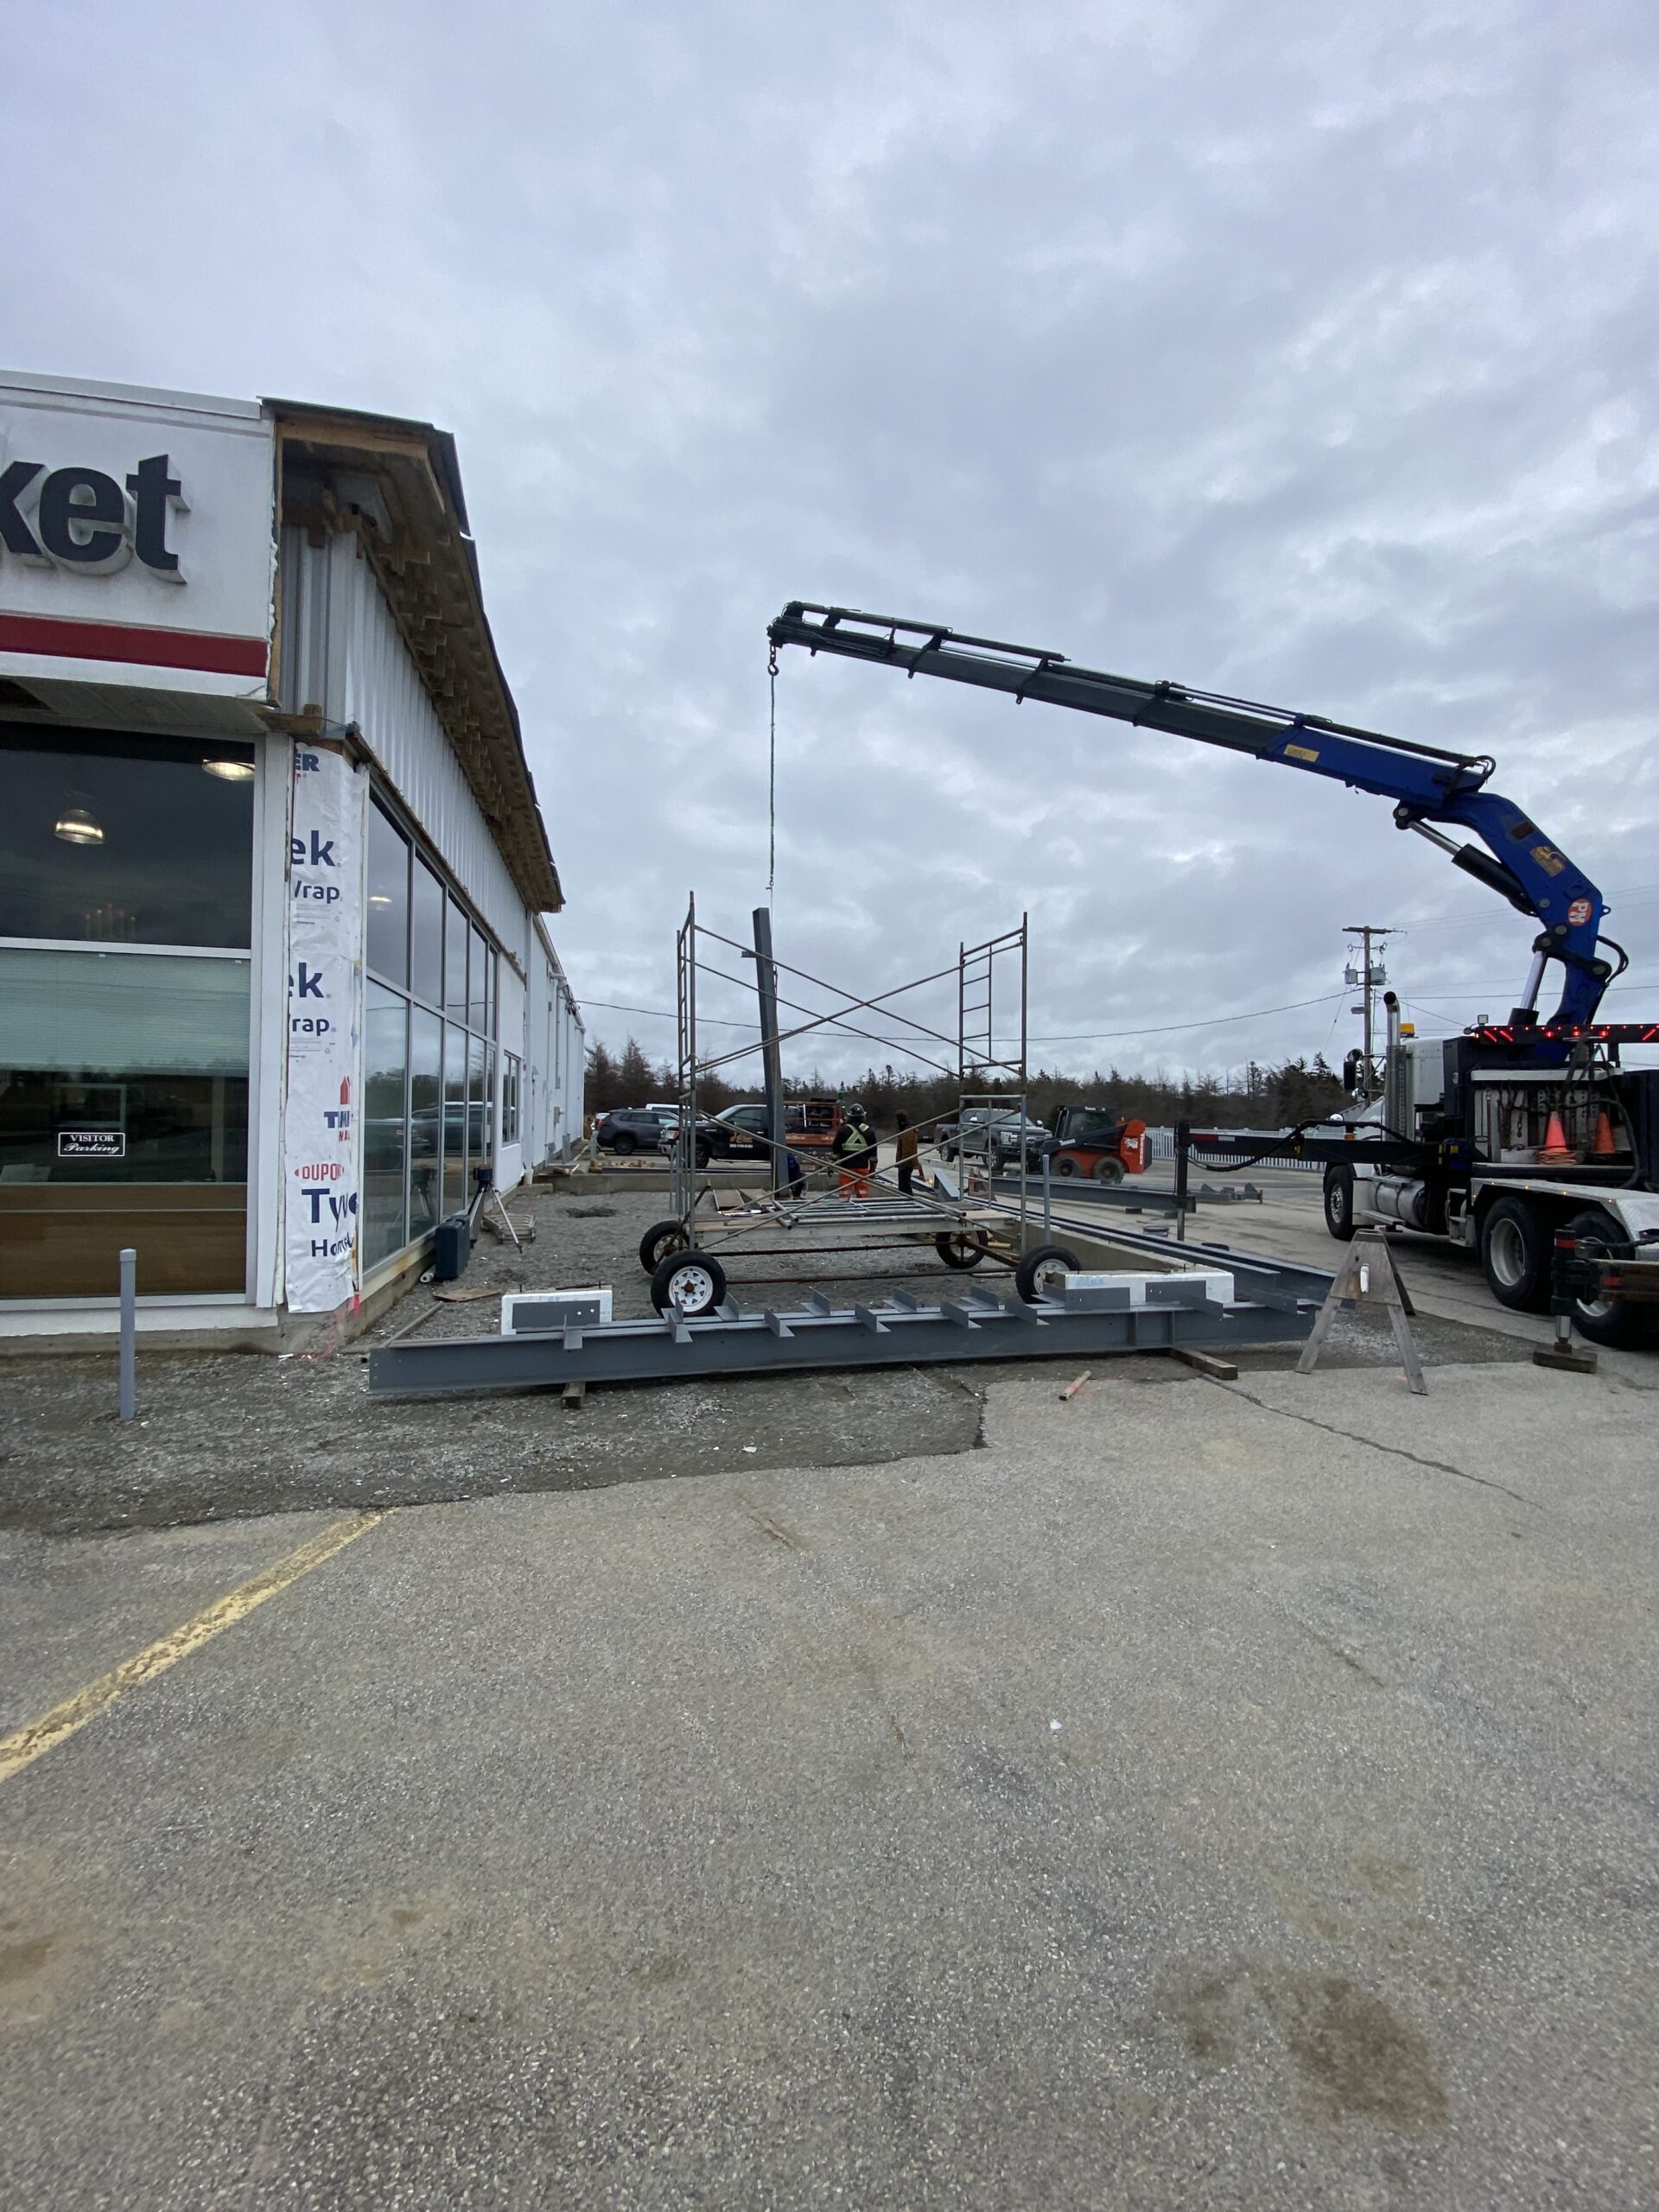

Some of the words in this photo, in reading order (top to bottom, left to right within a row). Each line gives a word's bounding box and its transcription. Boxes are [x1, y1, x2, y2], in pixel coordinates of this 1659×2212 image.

[291, 830, 335, 867] ek
[289, 1014, 330, 1037] rap
[63, 1142, 119, 1154] Parking
[302, 1163, 341, 1180] DUPO
